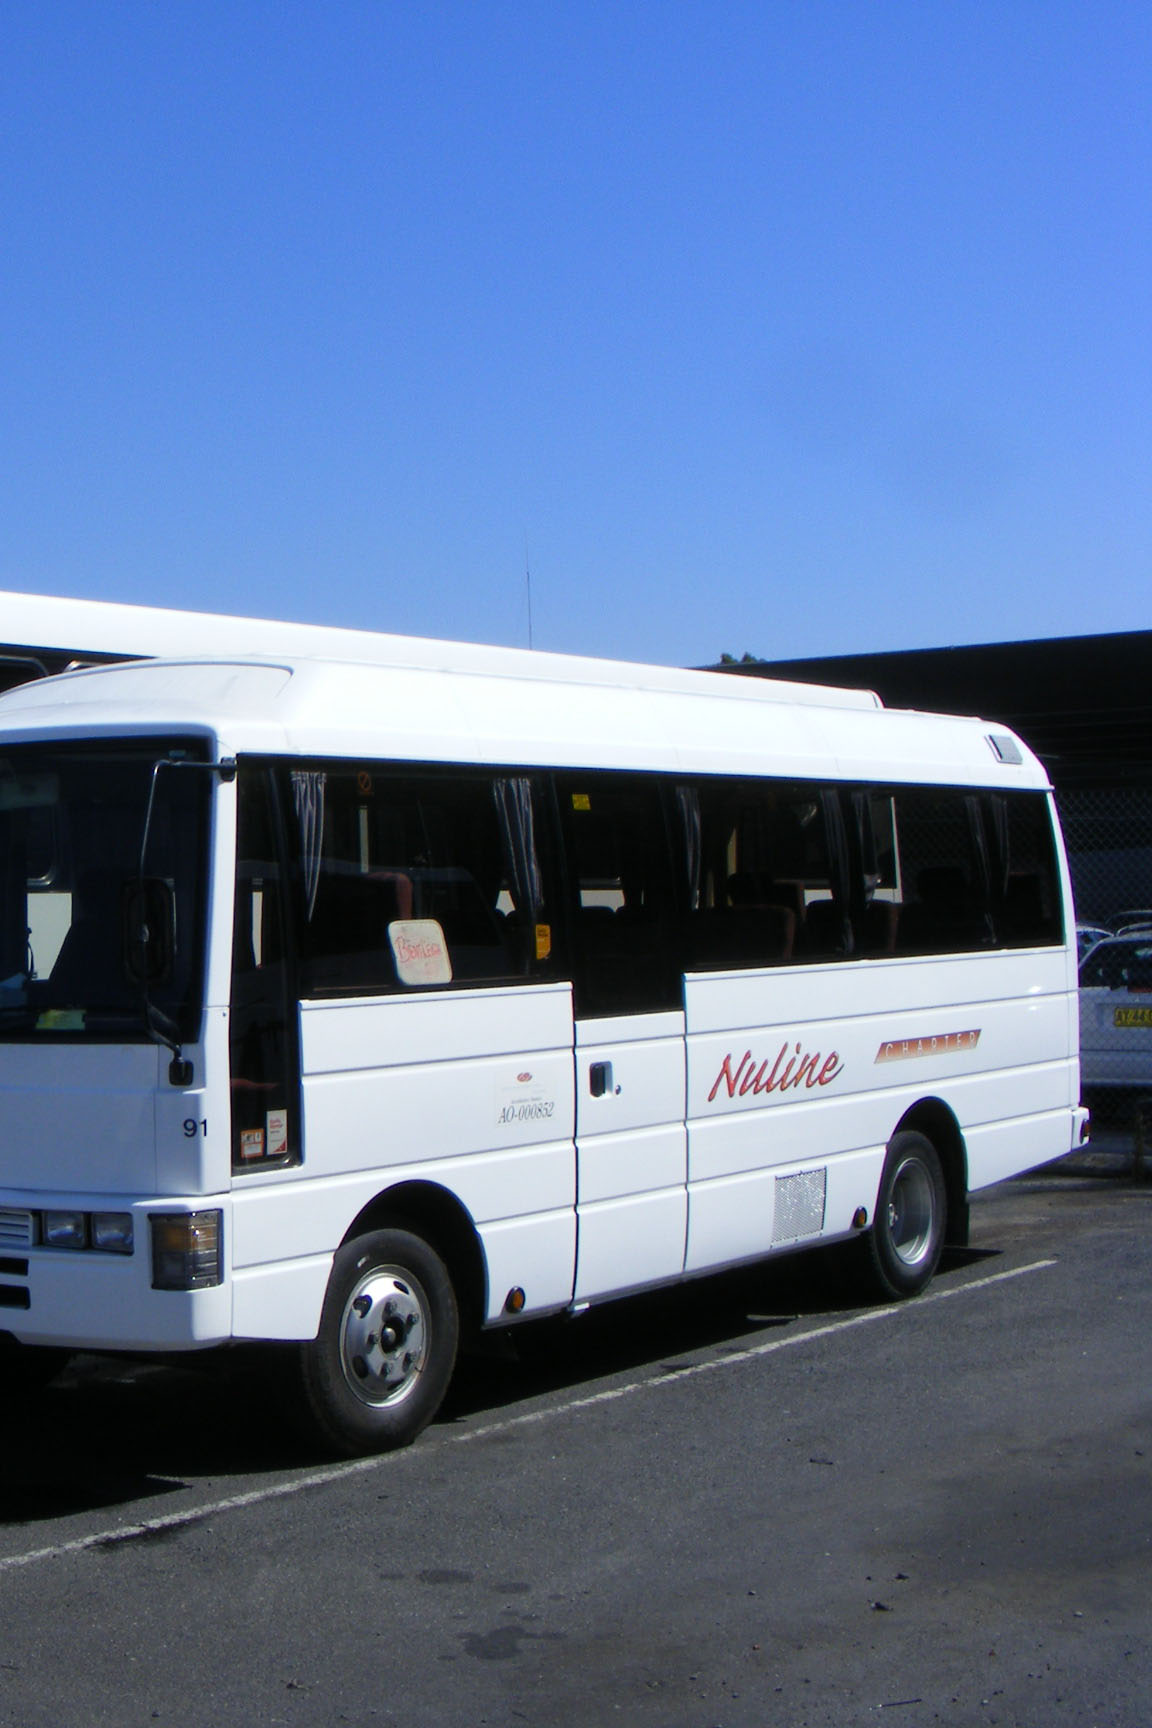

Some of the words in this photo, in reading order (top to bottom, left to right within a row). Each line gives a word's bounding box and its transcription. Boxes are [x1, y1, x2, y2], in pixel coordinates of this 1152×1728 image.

[885, 1032, 976, 1058] CHARTER
[708, 1041, 845, 1102] Nuline
[497, 1101, 555, 1124] AO-000852
[183, 1118, 208, 1138] 91
